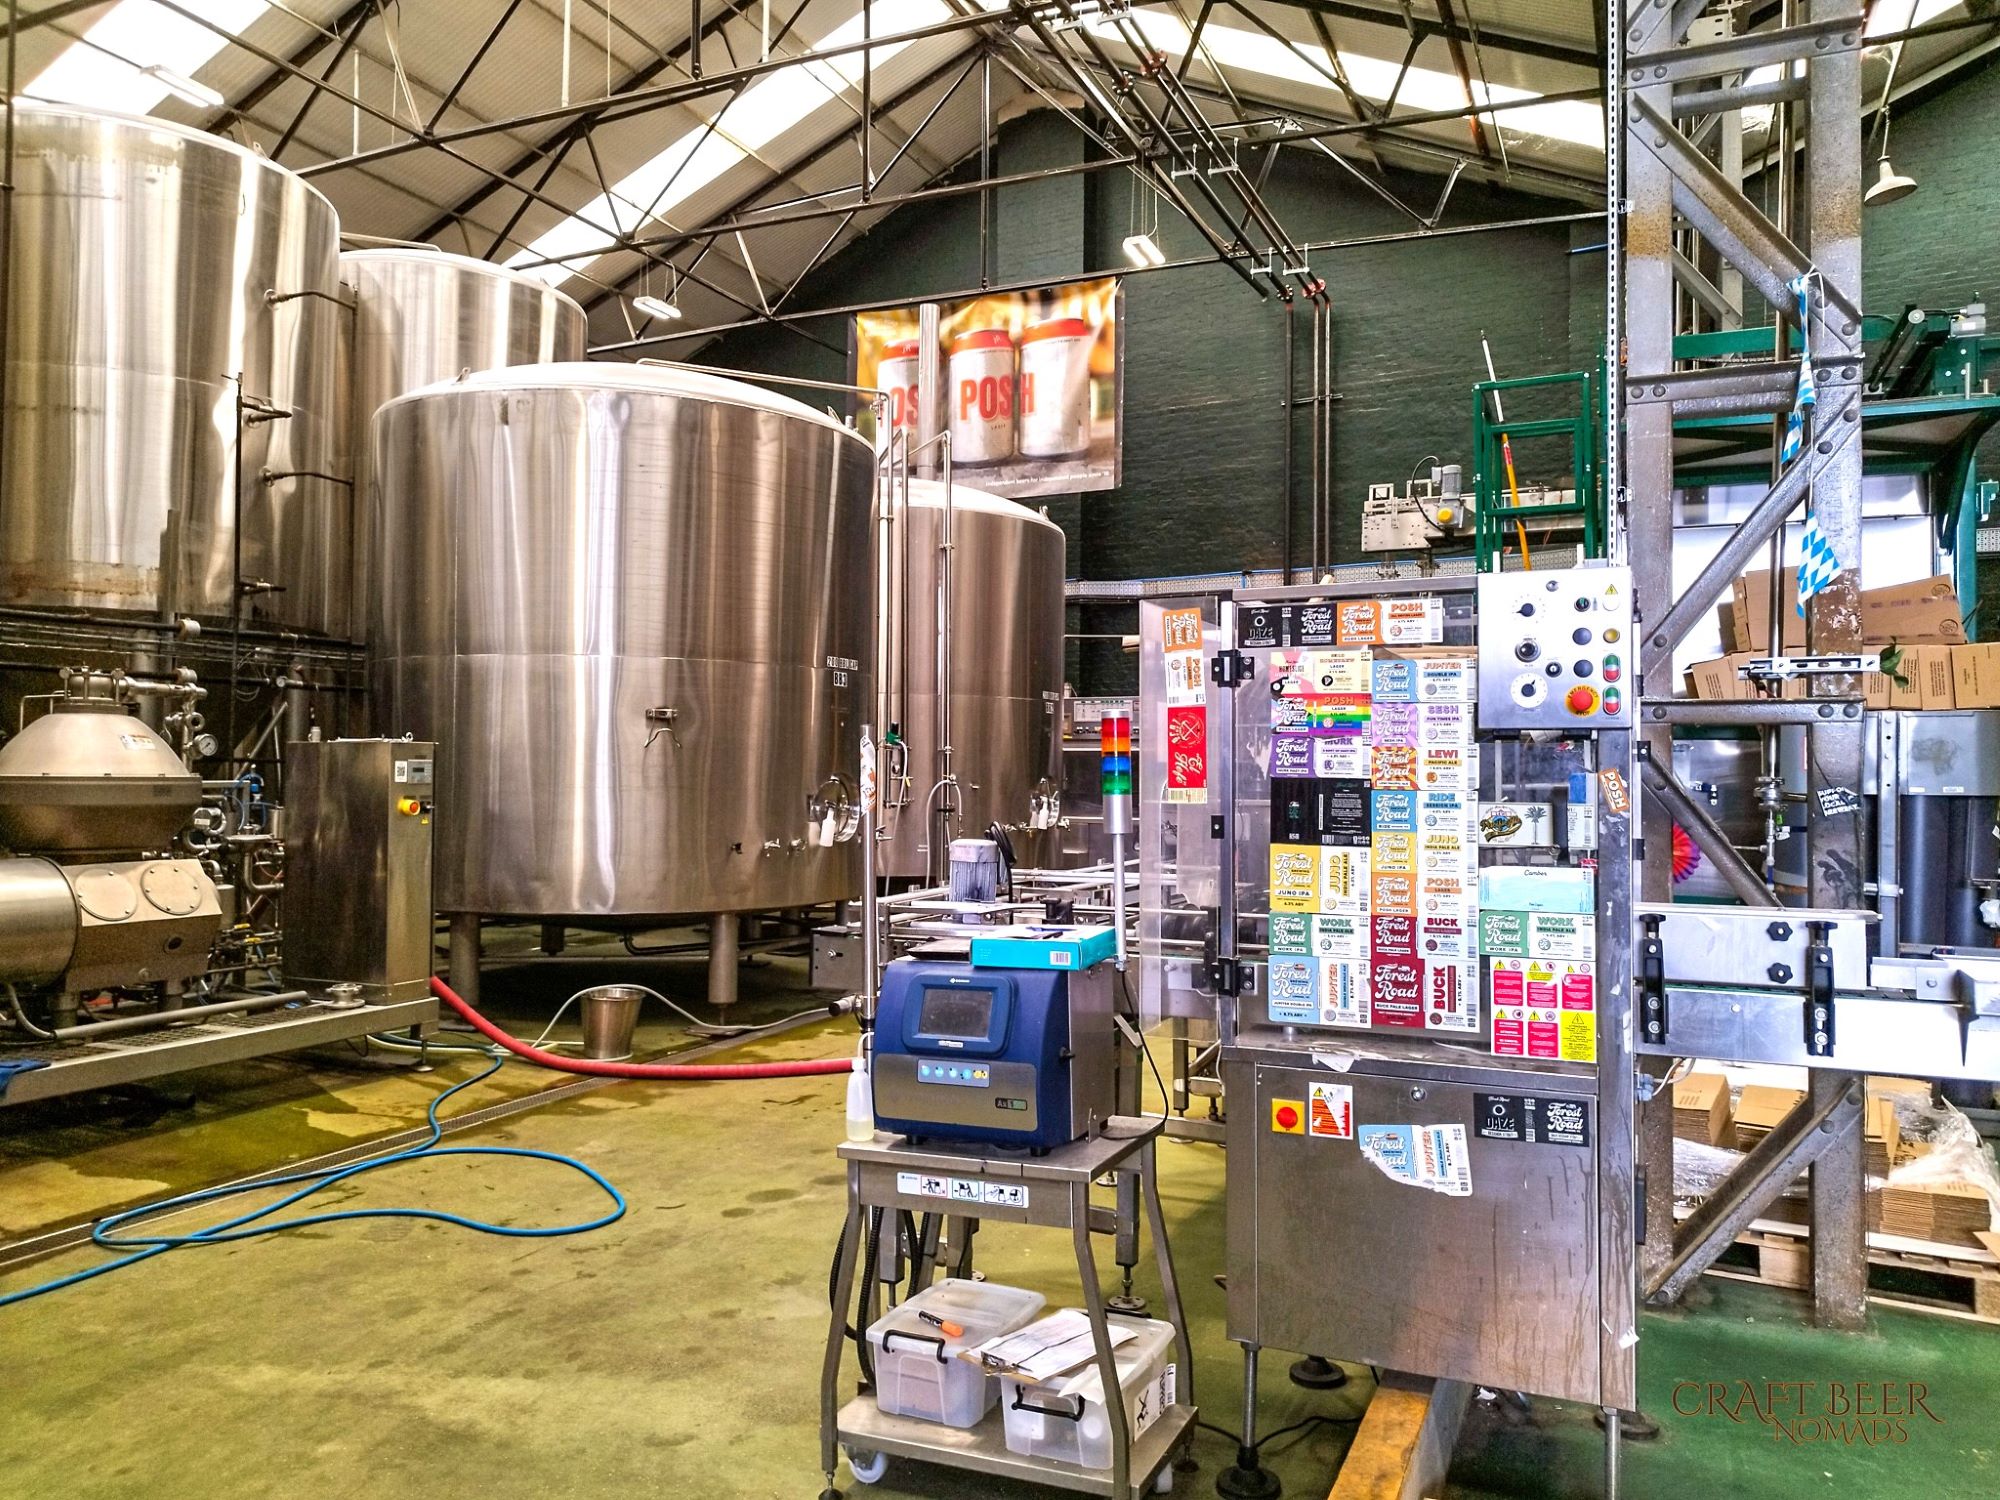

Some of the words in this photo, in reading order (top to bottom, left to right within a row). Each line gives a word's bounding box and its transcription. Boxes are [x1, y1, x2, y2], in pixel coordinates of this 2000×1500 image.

[959, 373, 1035, 422] POSH
[1301, 607, 1331, 622] Forest
[1341, 605, 1375, 622] Forest
[1391, 603, 1423, 613] POSH
[1301, 620, 1332, 634] Road
[1341, 620, 1375, 634] Road
[1193, 658, 1202, 687] POSH
[1376, 663, 1408, 678] Forest
[1424, 662, 1461, 670] JUPITER
[1376, 677, 1410, 691] Road
[1567, 685, 1600, 699] EMERGENCY
[1277, 697, 1307, 712] Forest
[1324, 697, 1354, 705] POSH
[1376, 706, 1410, 722] Forest
[1427, 705, 1459, 714] SESH
[1276, 711, 1308, 725] Road
[1376, 721, 1410, 736] Road
[1276, 737, 1308, 752] Forest
[1276, 751, 1309, 767] Road
[1376, 750, 1409, 765] Forest
[1428, 749, 1459, 759] LEWI
[1376, 763, 1410, 778] Road
[1604, 771, 1626, 808] POSH
[1376, 794, 1409, 808] Forest
[1428, 793, 1456, 802] RIDE
[1376, 807, 1410, 821] Road
[1376, 834, 1409, 848] Forest
[1426, 834, 1458, 843] JUNO
[1273, 853, 1313, 869] Forest
[1376, 847, 1410, 862] Road
[1273, 868, 1313, 887] Road
[1329, 855, 1341, 894] JUNO
[1426, 877, 1460, 887] POSH
[1376, 877, 1409, 891] Forest
[1376, 890, 1410, 905] Road
[1273, 917, 1305, 931] Forest
[1320, 918, 1352, 927] WORK
[1376, 917, 1409, 930] Forest
[1427, 918, 1458, 927] BUCK
[1485, 915, 1520, 929] Forest
[1537, 916, 1574, 926] WORK
[1273, 930, 1306, 945] Road
[1376, 930, 1410, 944] Road
[1485, 928, 1521, 944] Road
[1272, 962, 1311, 980] Forest
[1374, 963, 1417, 982] Forest
[1272, 979, 1313, 998] Road
[1329, 964, 1338, 1008] JUPITER
[1374, 981, 1418, 1000] Road
[1433, 966, 1446, 1010] BUCK
[1547, 1102, 1582, 1117] Forest
[1486, 1117, 1515, 1131] DAZE
[1547, 1116, 1583, 1132] Road
[1365, 1132, 1406, 1150] Forest
[1423, 1130, 1435, 1177] JUPITER
